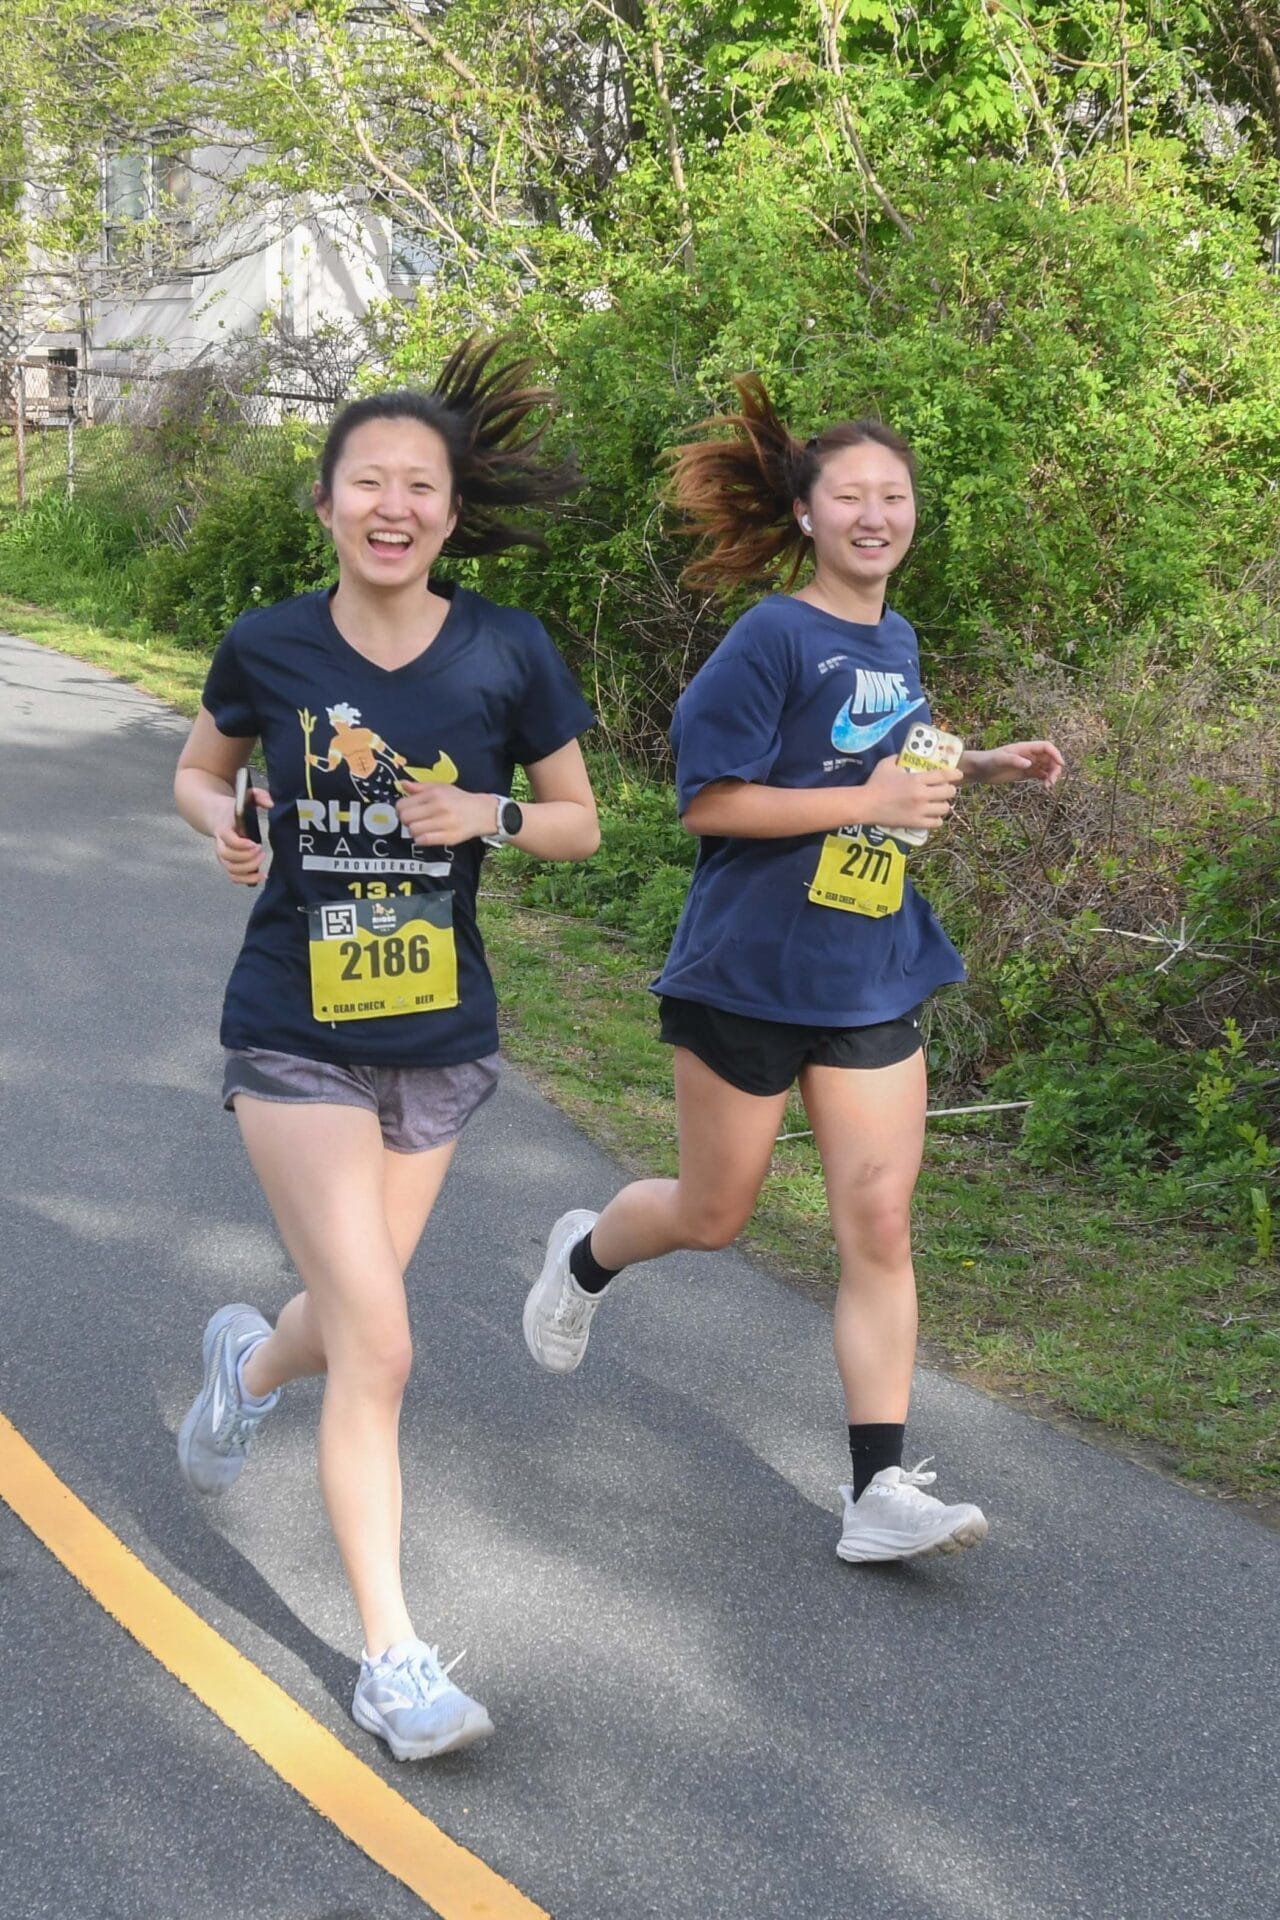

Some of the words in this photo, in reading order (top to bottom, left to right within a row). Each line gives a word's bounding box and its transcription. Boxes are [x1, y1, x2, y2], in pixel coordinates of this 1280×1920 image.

[852, 669, 910, 715] NIKE
[296, 799, 413, 839] RHO
[298, 834, 455, 862] RACES
[333, 859, 424, 872] PROVIDENCE
[839, 843, 892, 885] 2777
[348, 881, 413, 899] 13.1
[339, 934, 430, 981] 2186
[333, 1004, 356, 1014] GEAR
[358, 1000, 386, 1012] CHECK
[415, 994, 435, 1005] BEER
